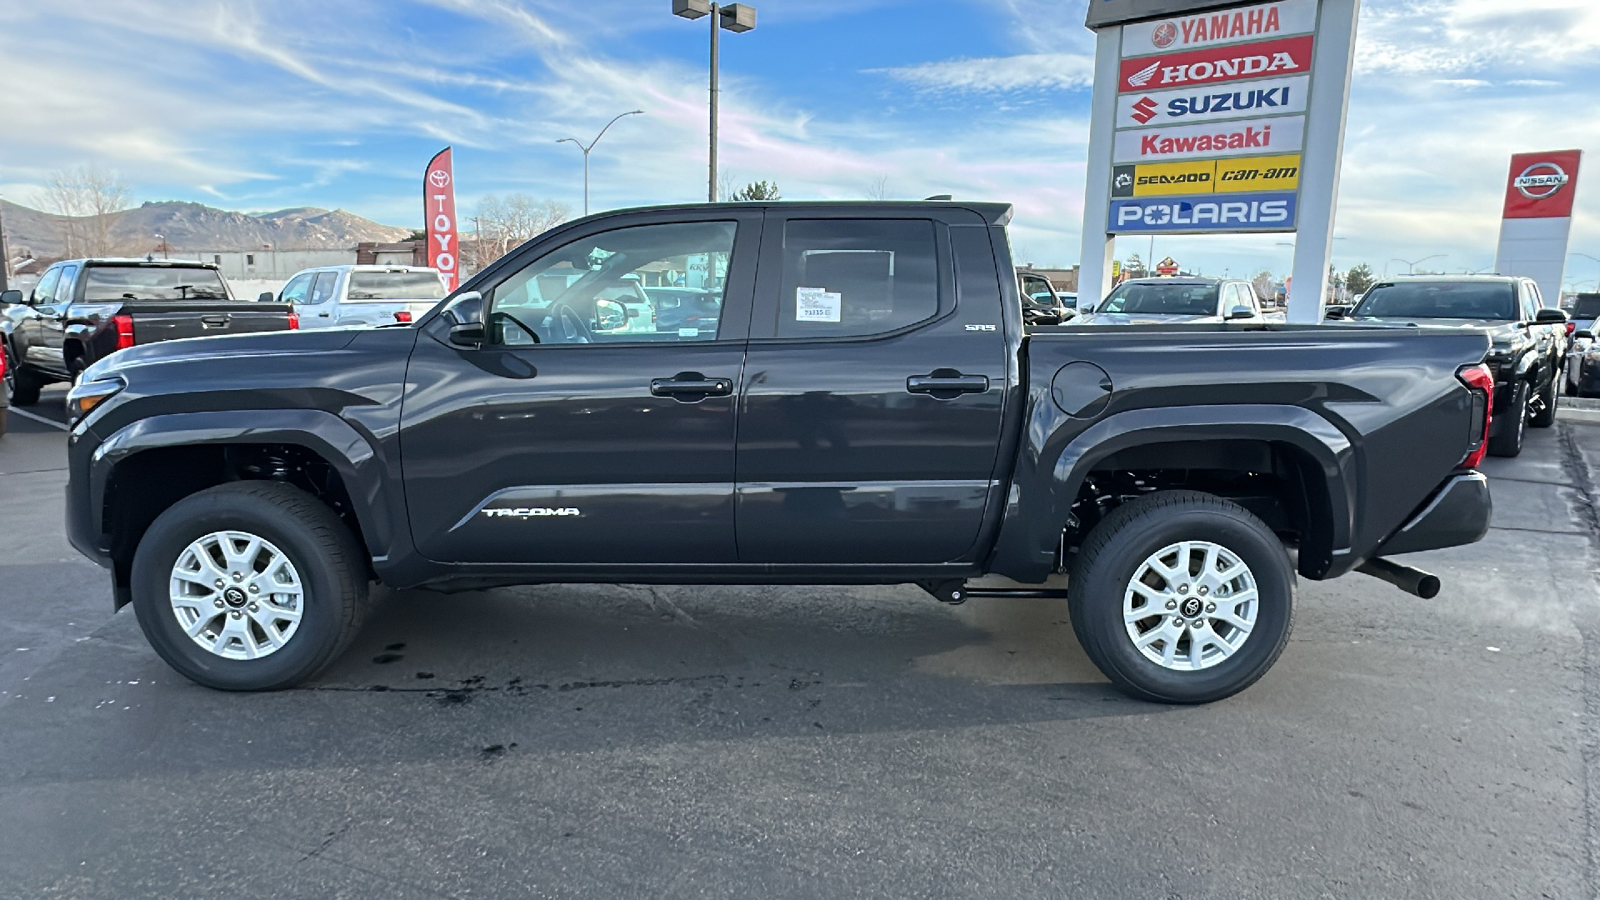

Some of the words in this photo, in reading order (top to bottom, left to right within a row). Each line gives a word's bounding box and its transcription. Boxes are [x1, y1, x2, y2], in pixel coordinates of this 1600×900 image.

[1181, 6, 1280, 44] YAMAHA
[1161, 52, 1298, 84] HONDA
[1167, 87, 1289, 117] SUZUKI
[1141, 125, 1271, 155] Kawasaki
[1117, 200, 1288, 226] POLARIS
[434, 194, 454, 294] TOYOT
[481, 508, 580, 517] TACOMA
